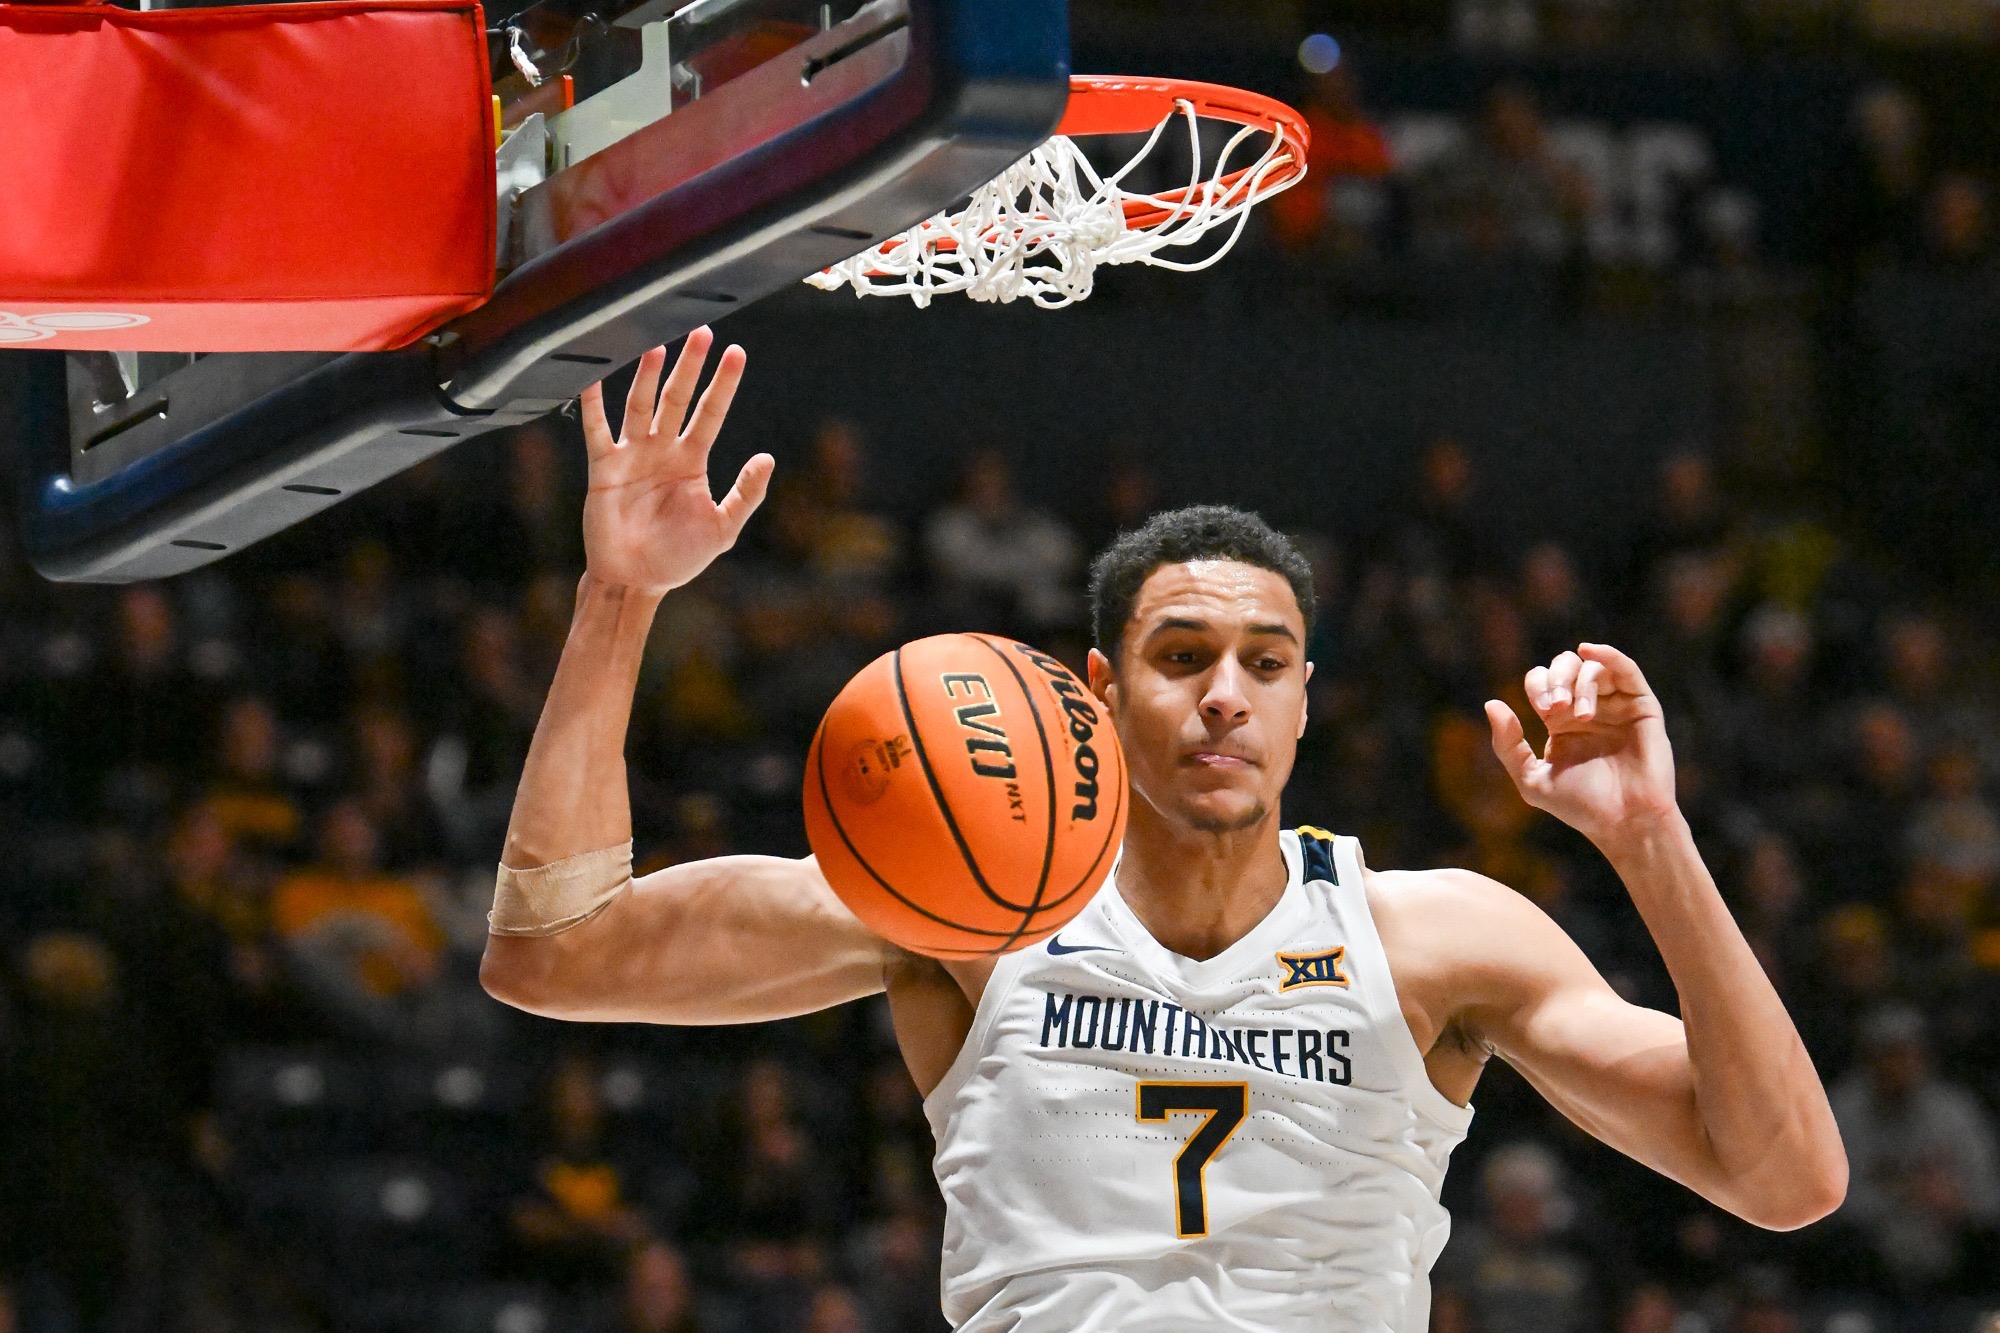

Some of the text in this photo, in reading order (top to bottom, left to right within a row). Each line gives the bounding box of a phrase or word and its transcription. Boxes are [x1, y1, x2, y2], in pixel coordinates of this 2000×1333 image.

[940, 672, 1017, 779] EVO
[1279, 949, 1347, 990] XII
[1040, 992, 1352, 1087] MOUNTAINEERS
[1136, 1081, 1248, 1239] 7
